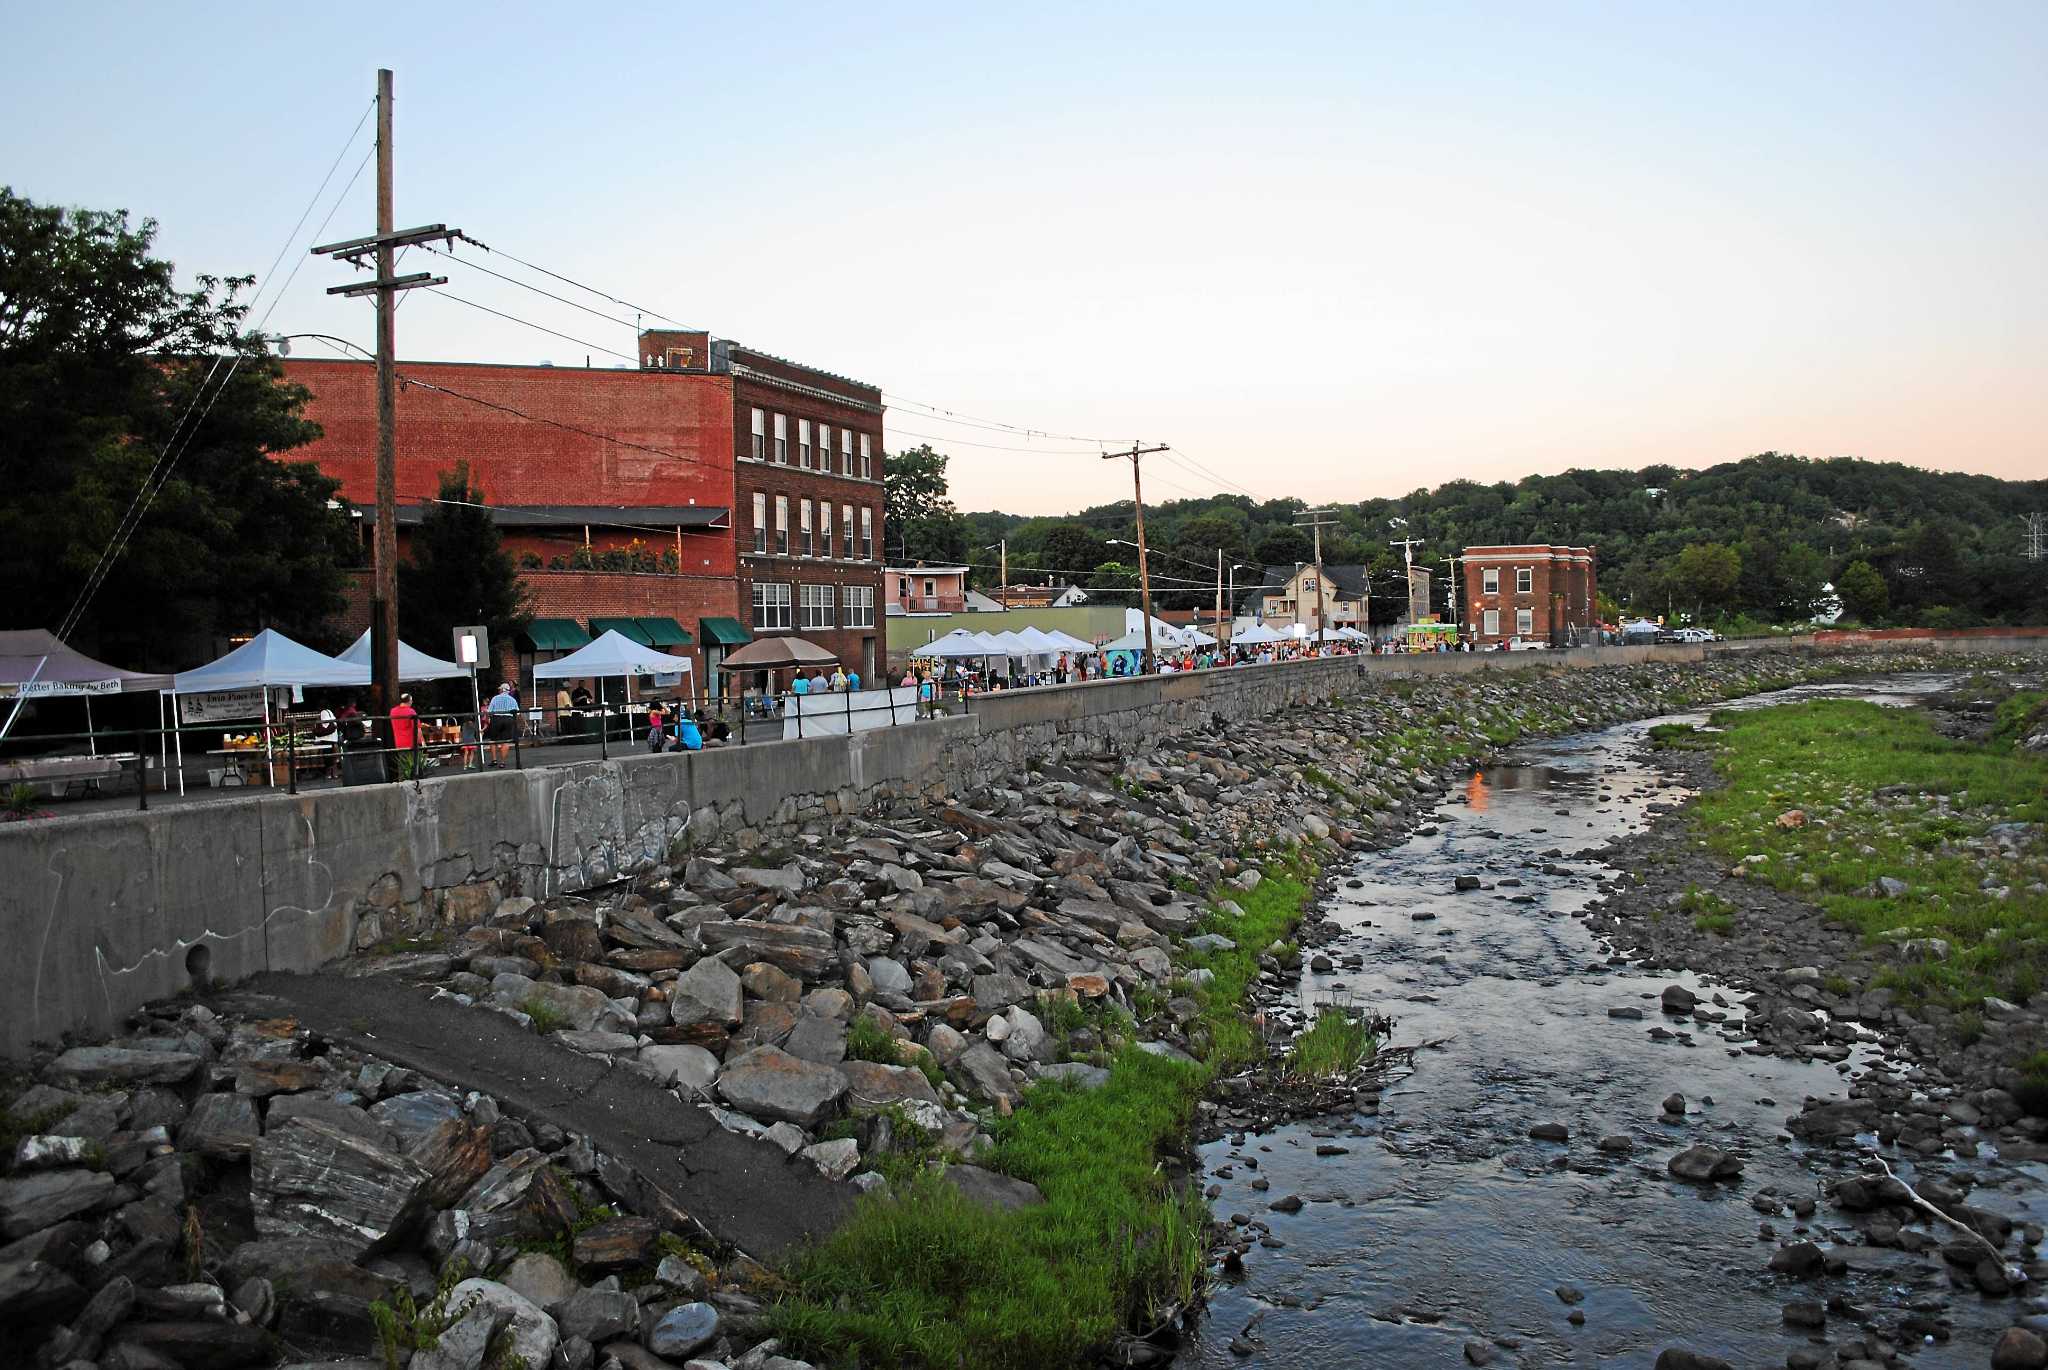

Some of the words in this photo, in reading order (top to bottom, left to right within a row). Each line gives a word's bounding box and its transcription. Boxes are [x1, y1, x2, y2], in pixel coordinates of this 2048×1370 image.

[53, 681, 84, 691] Baking
[87, 682, 99, 690] by
[100, 679, 119, 690] Beth
